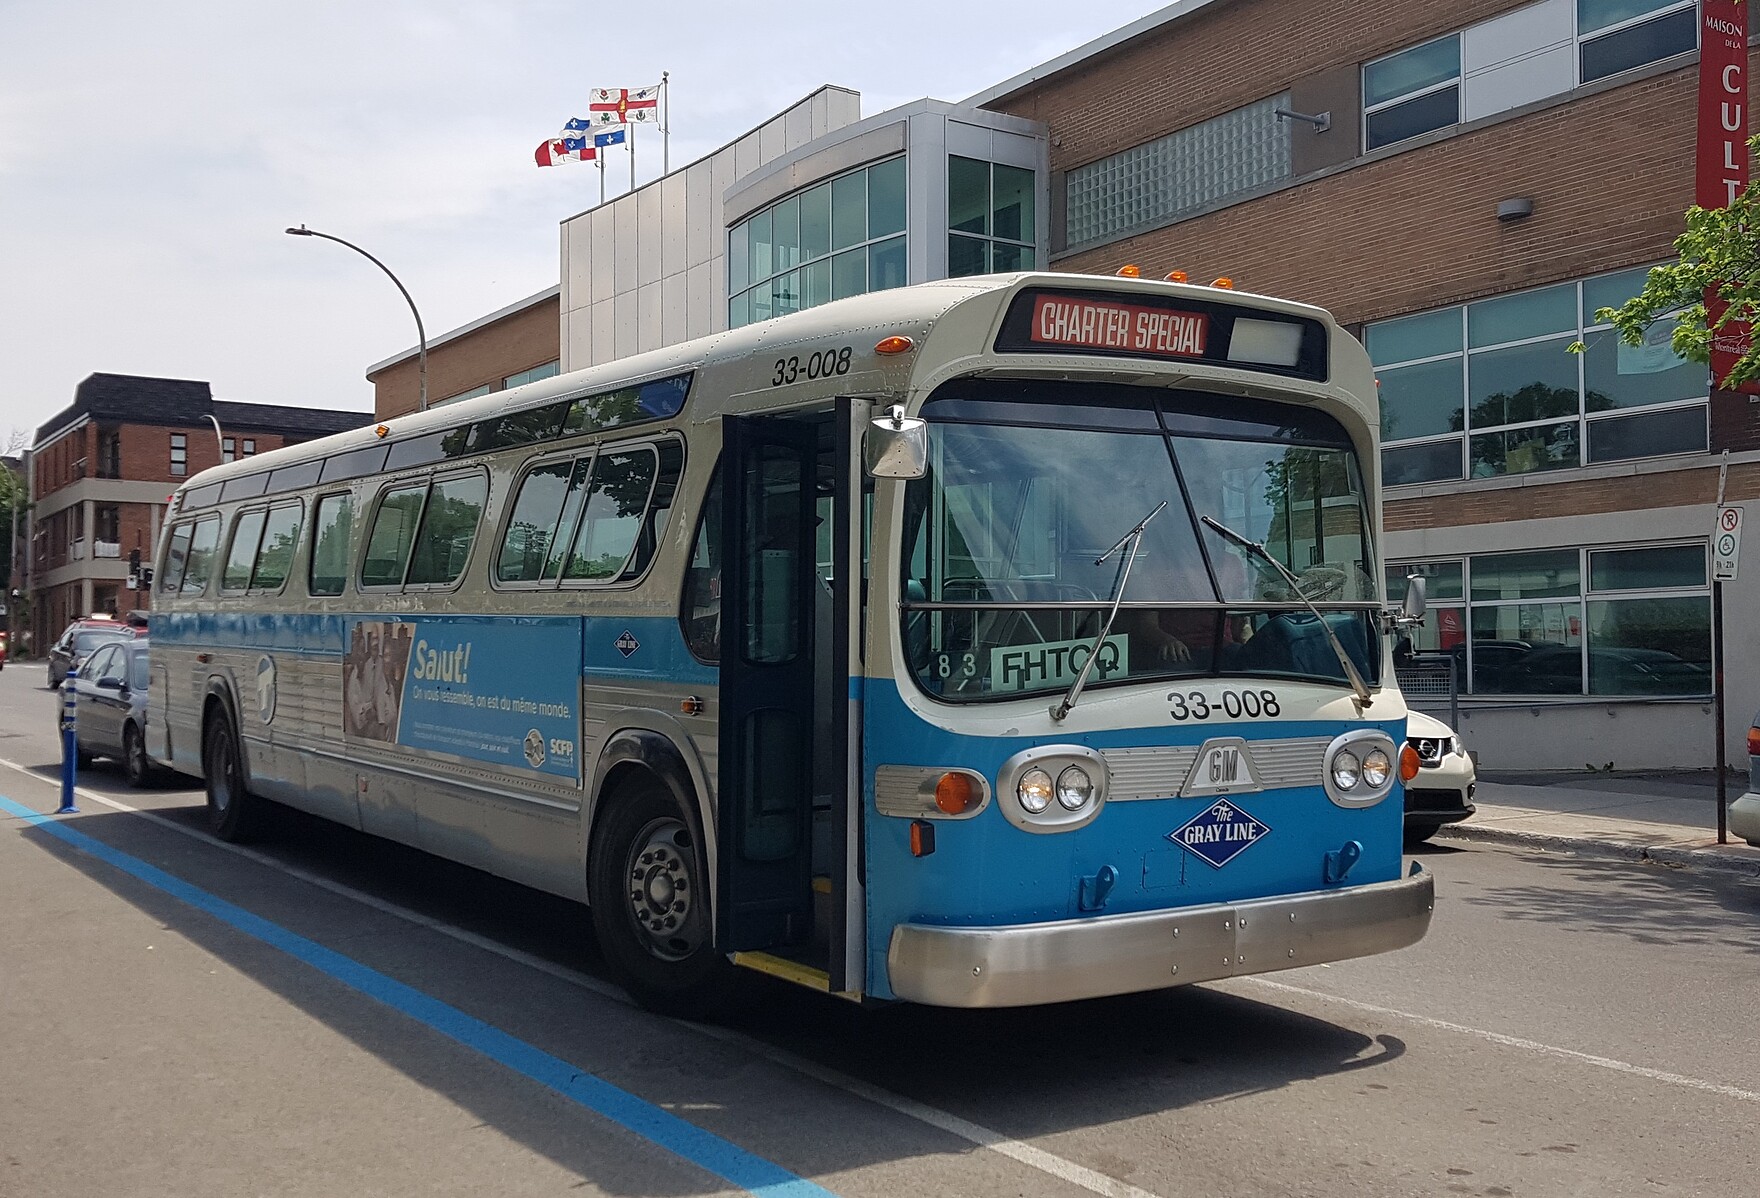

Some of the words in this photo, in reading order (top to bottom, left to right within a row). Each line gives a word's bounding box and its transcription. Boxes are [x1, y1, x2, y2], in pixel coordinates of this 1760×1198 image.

[1705, 14, 1743, 37] MAISON
[1725, 39, 1732, 48] DE
[1732, 41, 1741, 49] LA
[1721, 64, 1742, 228] CULT
[1040, 302, 1130, 347] CHARTER
[1135, 312, 1204, 355] SPECIAL
[772, 346, 853, 387] 33-008
[413, 639, 471, 684] Salut!
[938, 654, 950, 678] 8
[962, 653, 977, 677] 3
[413, 685, 423, 699] On
[424, 689, 440, 701] vous
[476, 696, 487, 708] on
[487, 695, 499, 710] est
[500, 696, 511, 711] du
[512, 697, 537, 714] même
[539, 702, 572, 719] monde.
[1167, 690, 1281, 721] 33-008
[1209, 750, 1238, 783] GM
[1212, 804, 1233, 822] The
[1184, 823, 1223, 845] GRAY
[1225, 822, 1257, 841] LINE
